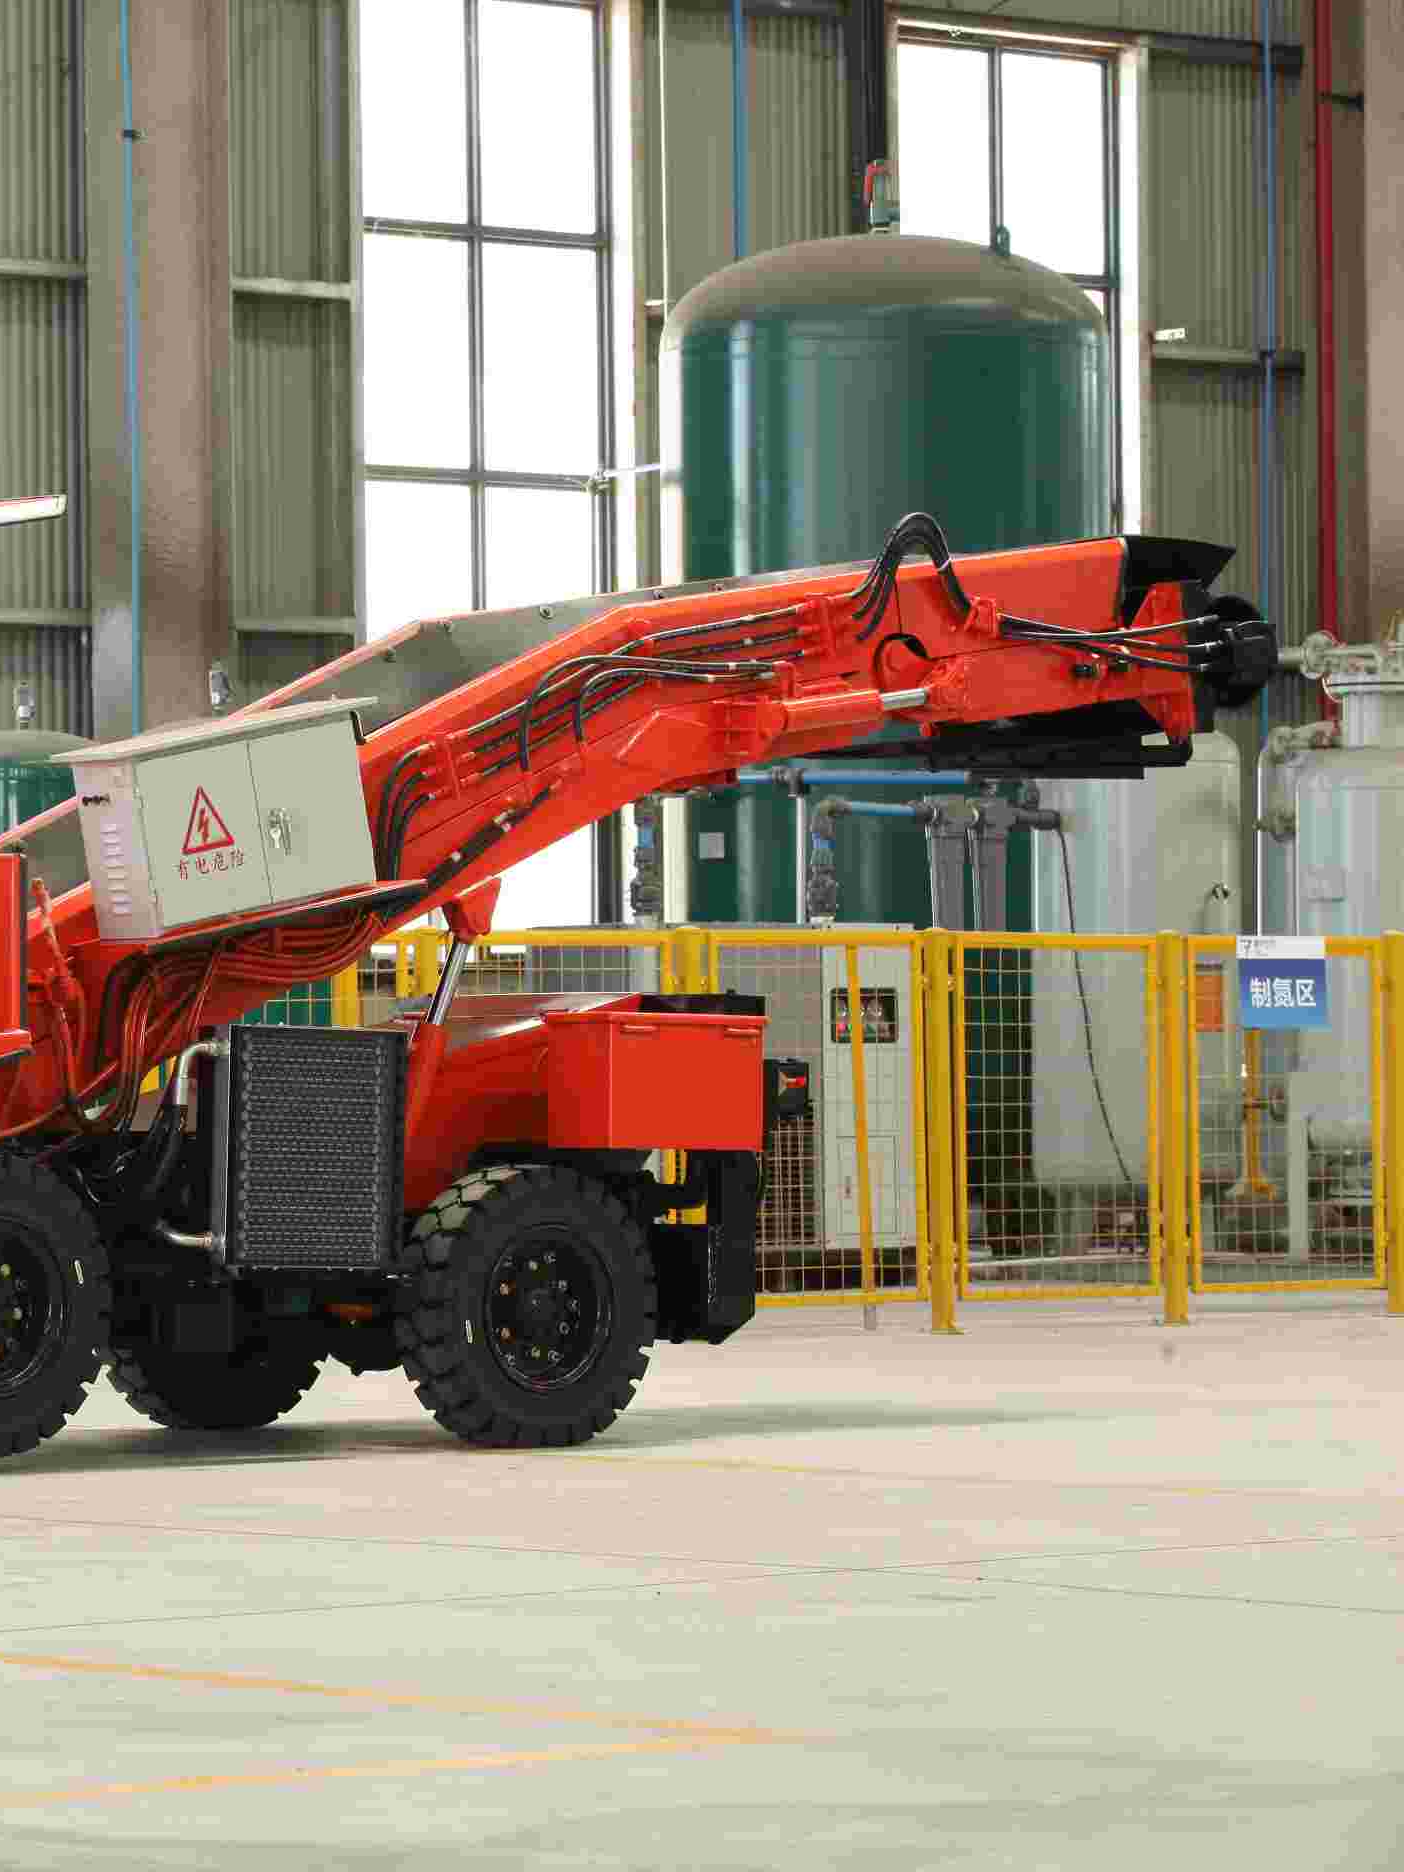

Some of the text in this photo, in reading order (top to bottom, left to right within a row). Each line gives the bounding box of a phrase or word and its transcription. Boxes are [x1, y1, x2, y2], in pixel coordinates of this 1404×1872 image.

[175, 848, 244, 880] 有电危险
[1250, 976, 1316, 1008] 制氮区
